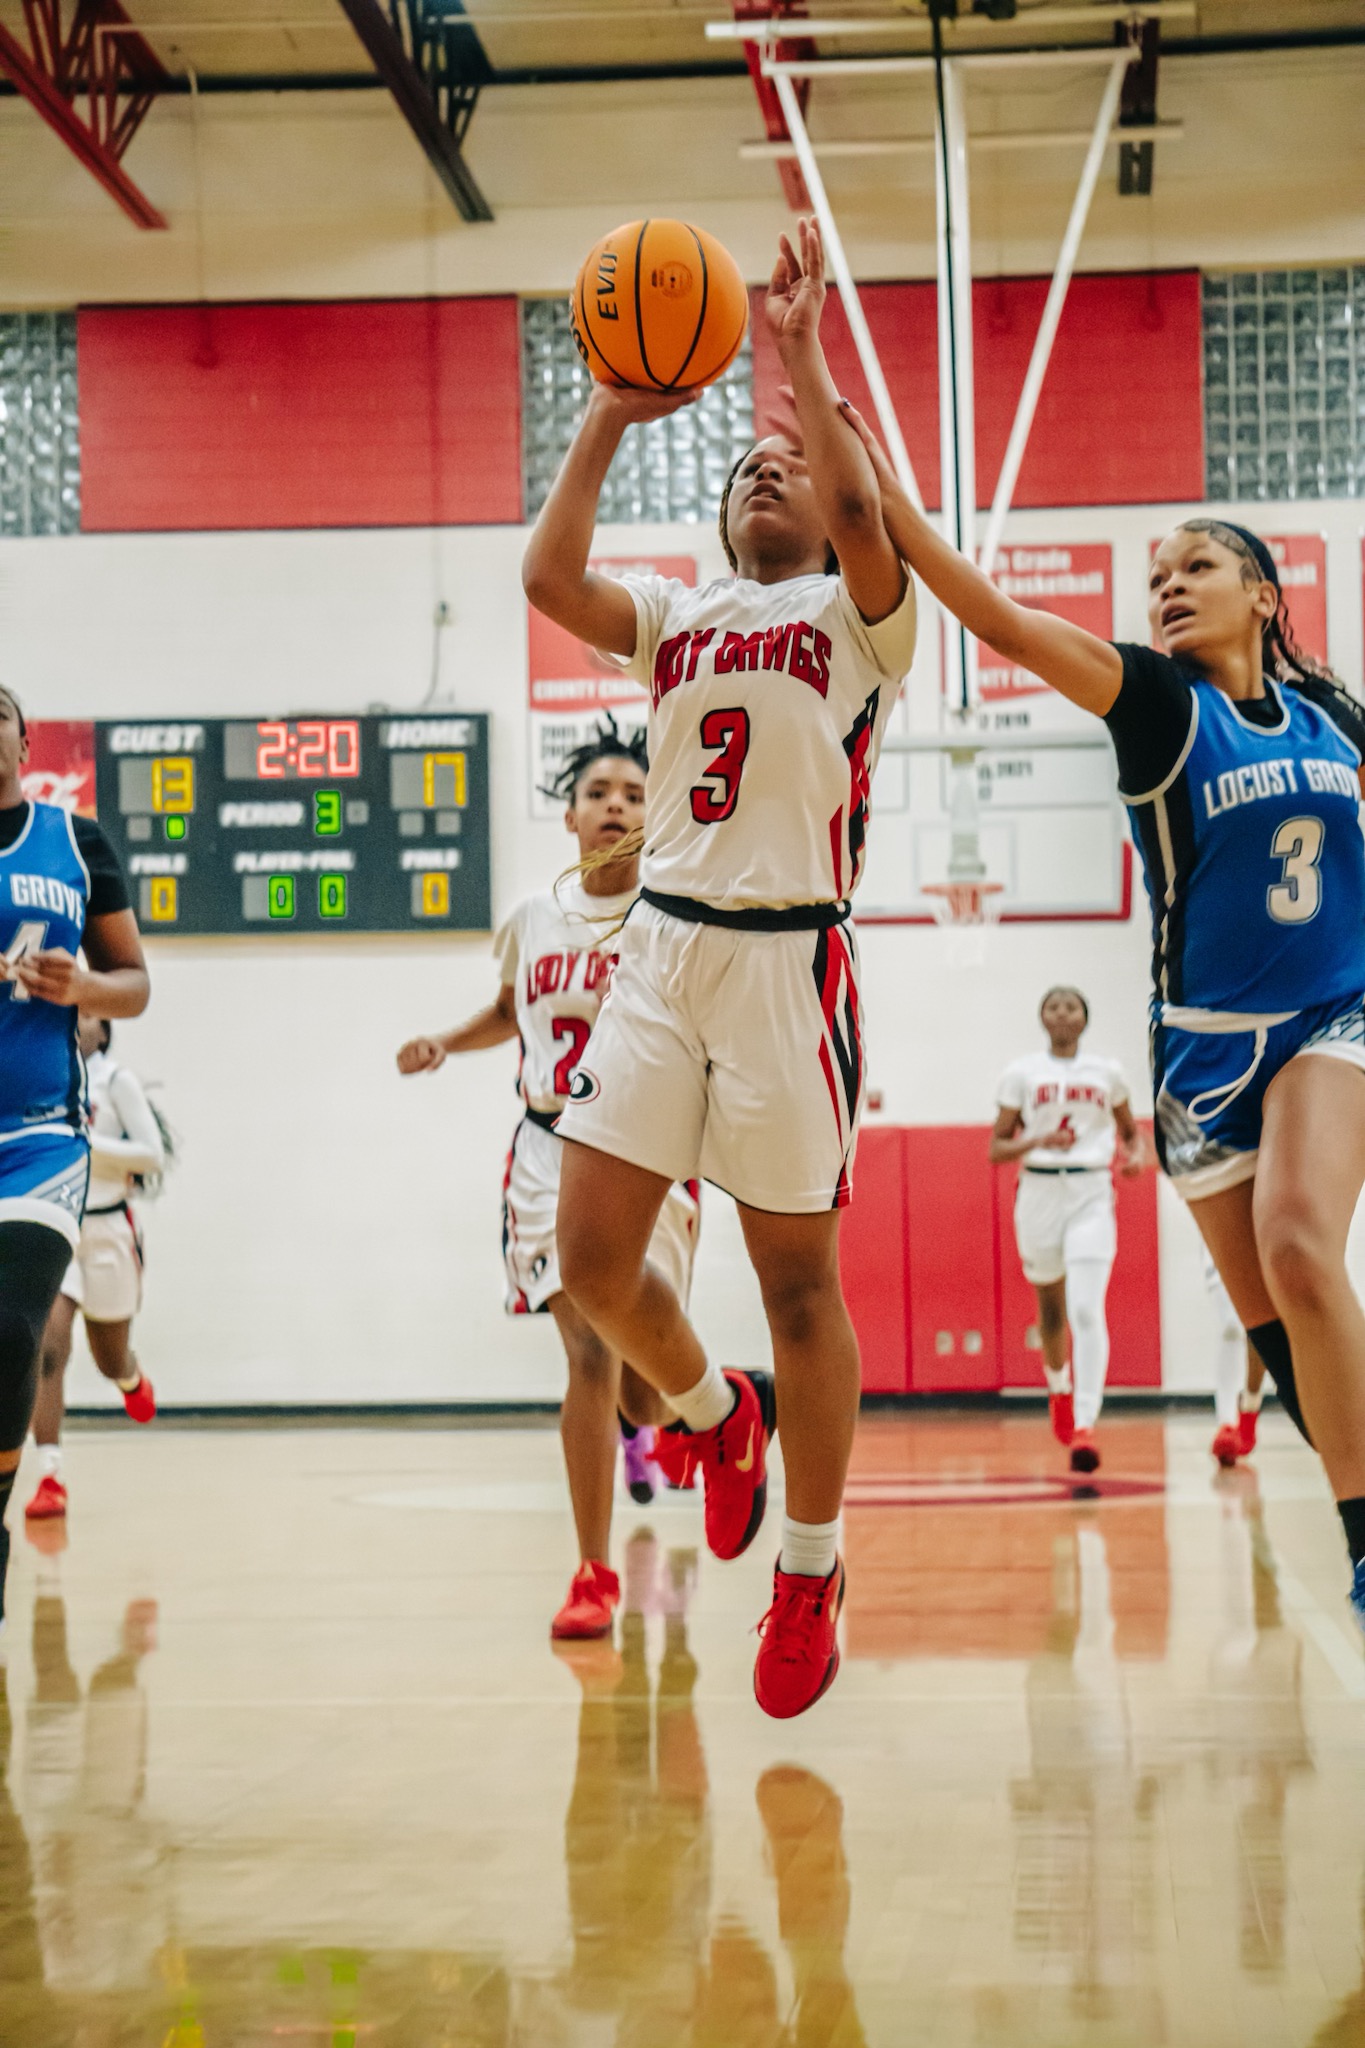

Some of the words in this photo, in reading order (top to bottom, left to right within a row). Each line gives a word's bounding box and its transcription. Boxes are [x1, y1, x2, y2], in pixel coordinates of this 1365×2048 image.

[714, 621, 832, 700] DAWGS
[257, 721, 360, 779] 2:20
[690, 707, 750, 825] 3
[152, 757, 193, 813] 13
[424, 752, 466, 807] 17
[1203, 758, 1299, 820] LOCUST
[314, 790, 341, 835] 3
[269, 875, 295, 919] 0
[319, 873, 346, 918] 0
[423, 872, 449, 915] 0
[1266, 815, 1325, 925] 3
[151, 877, 177, 921] 0
[552, 1017, 591, 1095] 2
